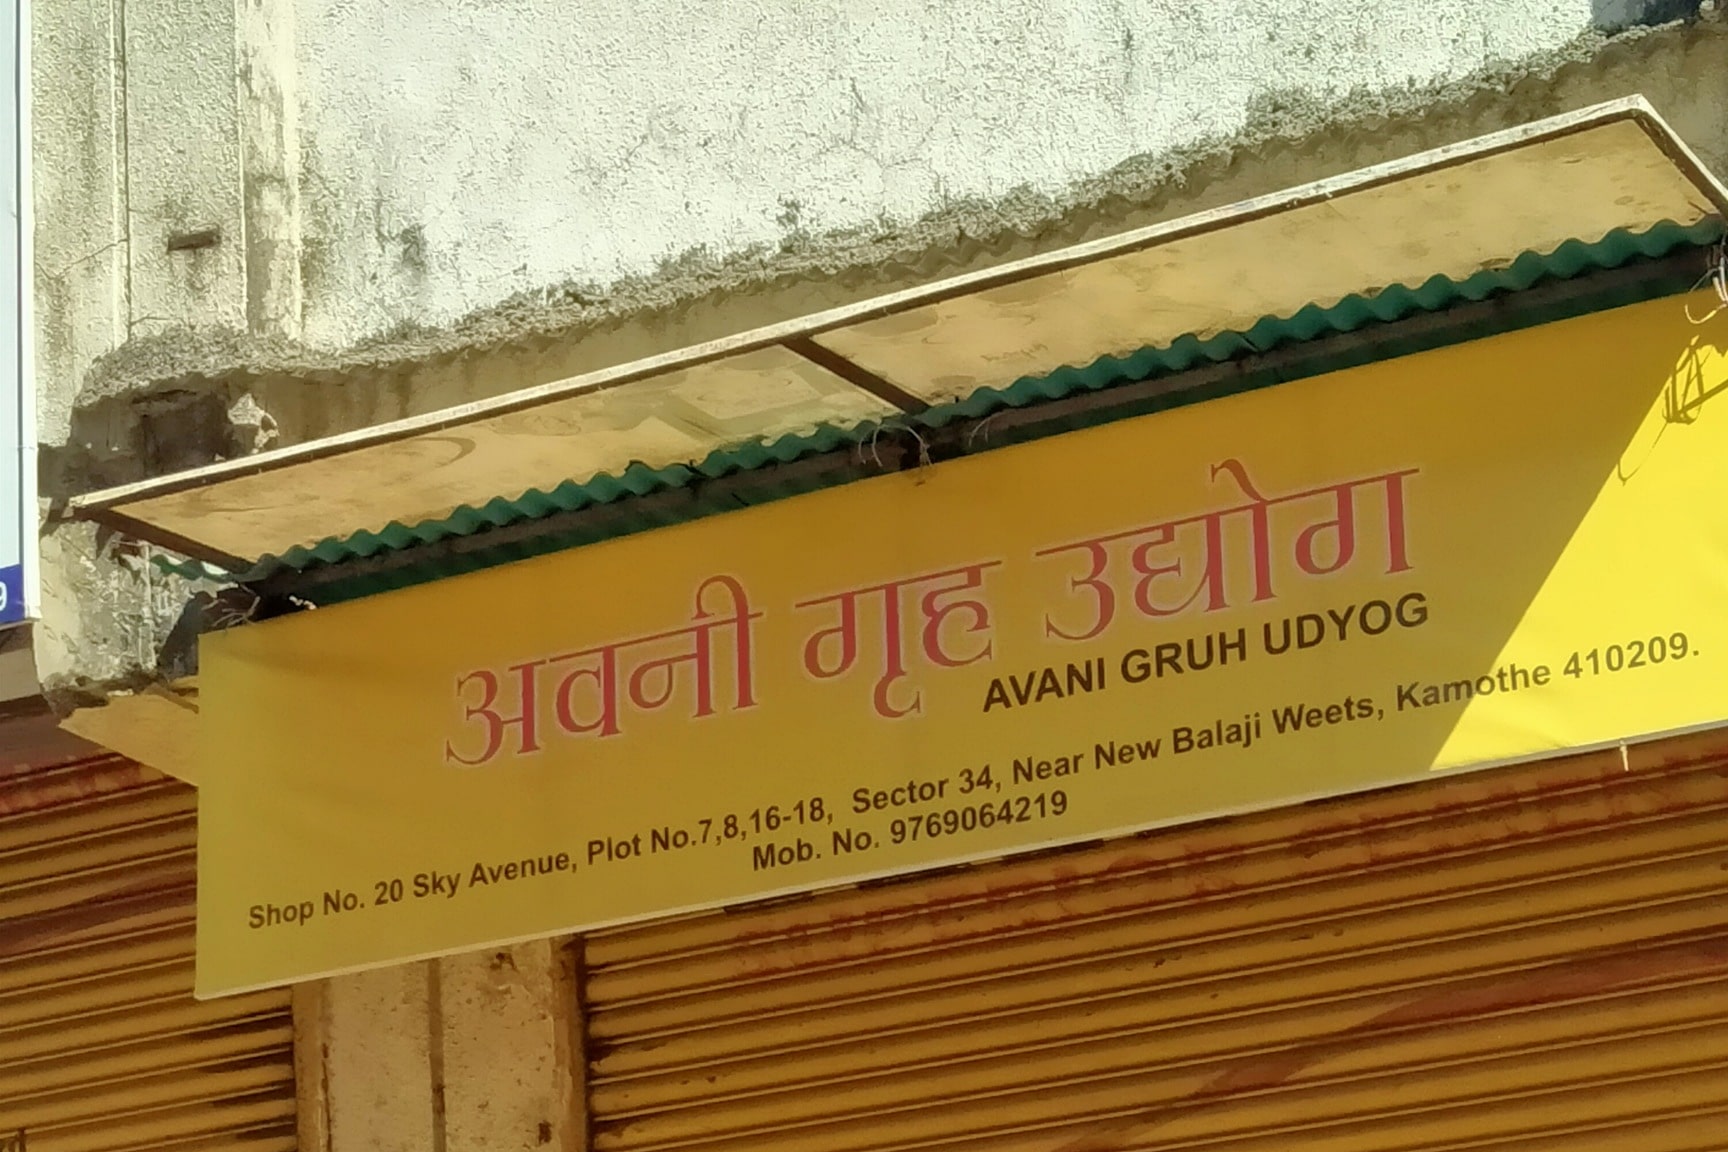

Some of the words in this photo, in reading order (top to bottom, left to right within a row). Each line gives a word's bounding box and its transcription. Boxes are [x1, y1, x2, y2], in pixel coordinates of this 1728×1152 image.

[444, 574, 764, 768] अवनी
[794, 560, 1003, 719] गृह
[1035, 458, 1421, 645] उद्योग
[982, 657, 1107, 713] AVANI
[1120, 627, 1247, 684] GRUH
[1263, 592, 1429, 656] UDYOG
[248, 901, 315, 929] Shop
[322, 889, 365, 916] No.
[374, 879, 404, 906] 20
[413, 870, 461, 899] Sky
[468, 851, 577, 888] Avenue,
[587, 833, 641, 865] Plot
[852, 777, 949, 814] Sector
[958, 764, 1002, 794] 34,
[1012, 753, 1084, 785] Near
[1094, 739, 1162, 770] New
[1172, 711, 1262, 754] Balaji
[1272, 696, 1385, 735] Weets,
[1396, 663, 1551, 712] Kamothe
[1562, 632, 1700, 679] 410209.
[752, 838, 822, 871] Mob.
[832, 828, 880, 855] No.
[890, 790, 1068, 845] 9769064219
